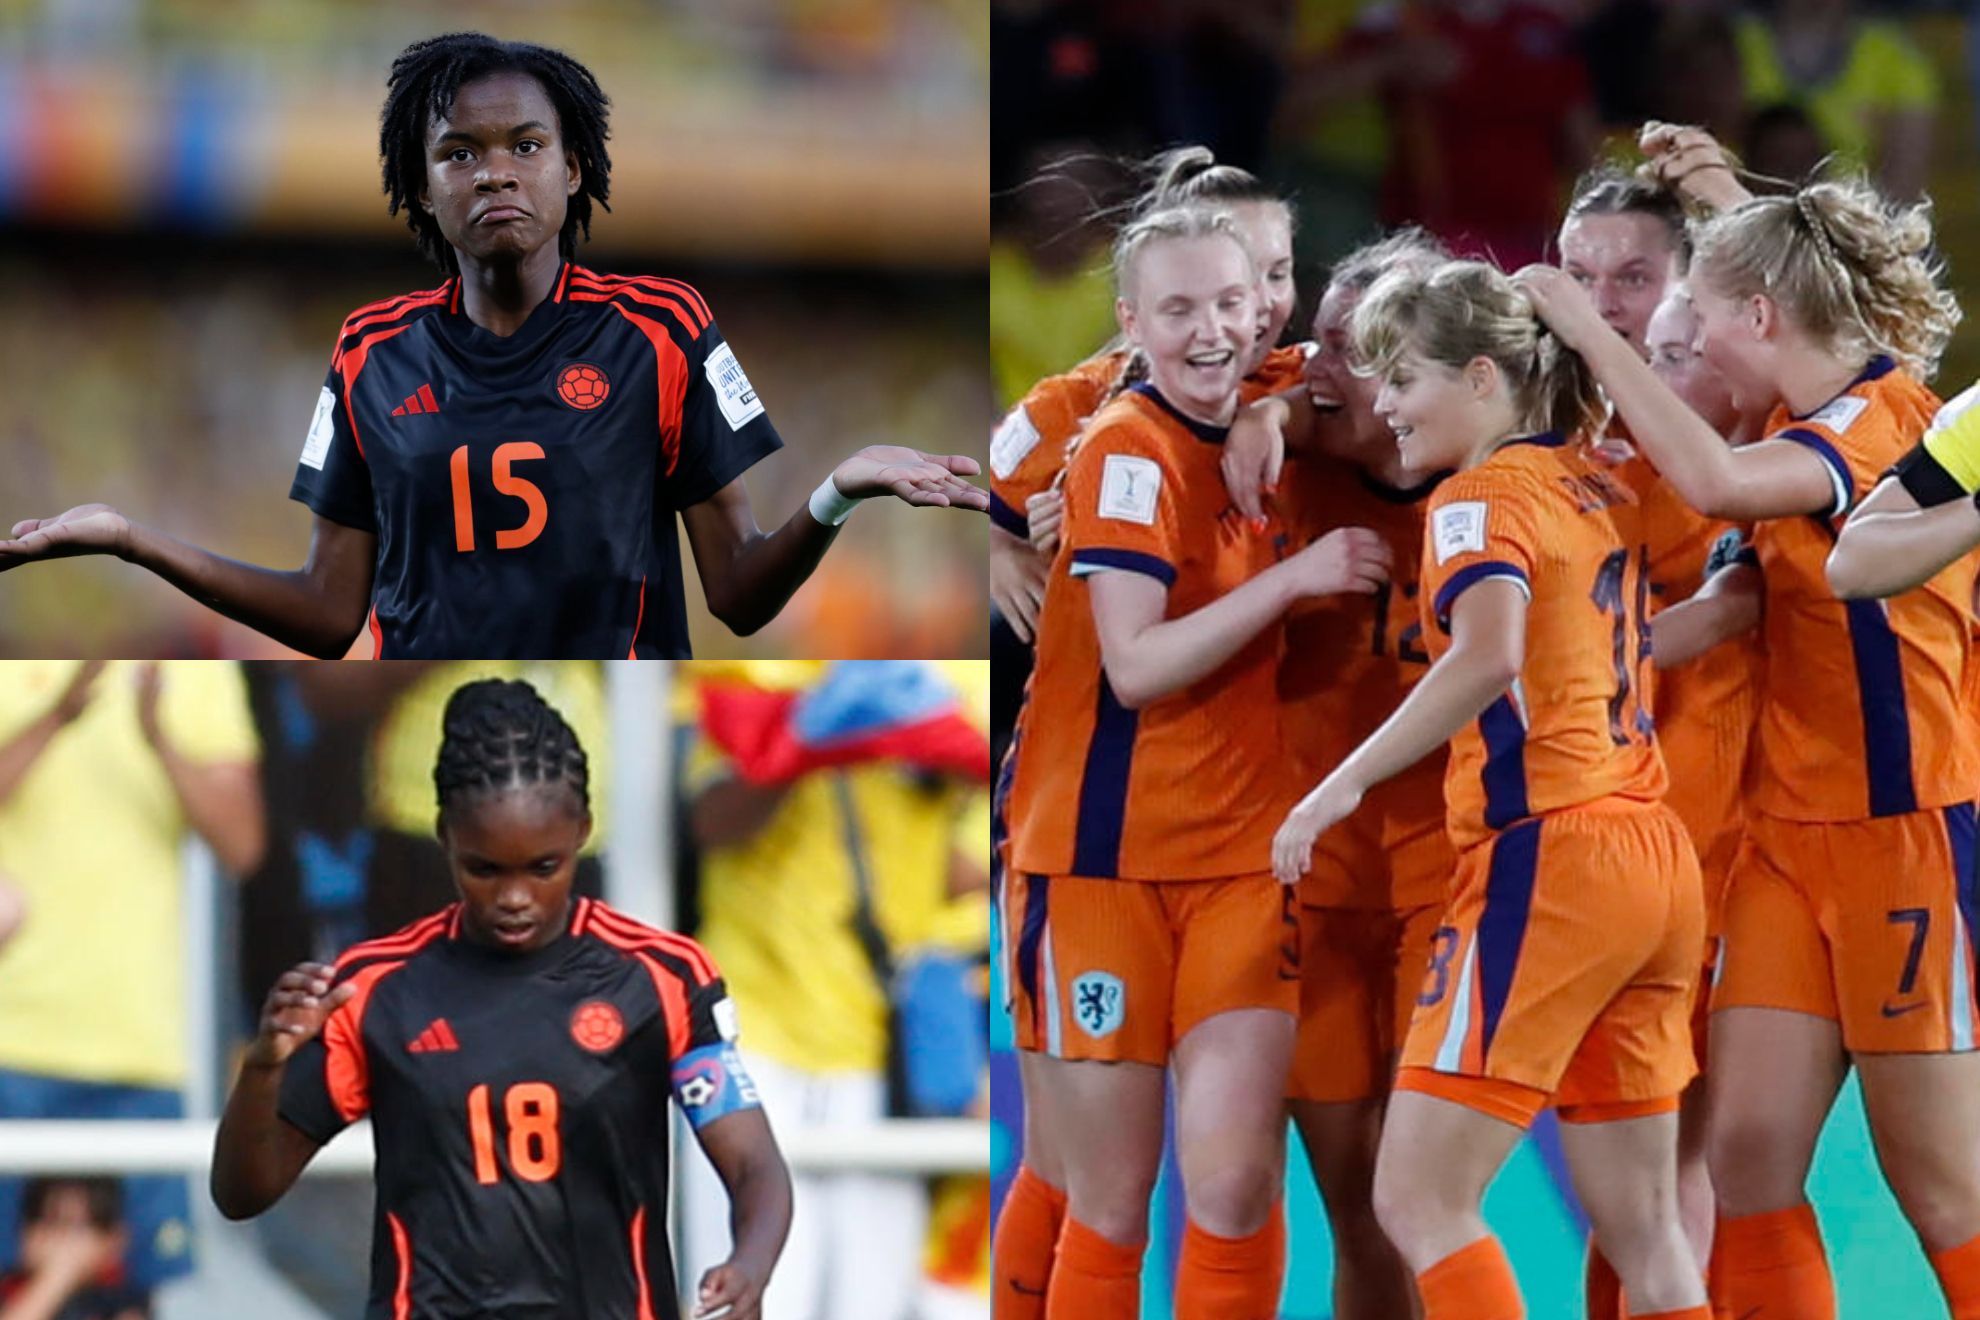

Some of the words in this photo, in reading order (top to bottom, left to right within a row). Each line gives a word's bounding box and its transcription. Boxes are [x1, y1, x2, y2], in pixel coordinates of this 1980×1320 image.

[724, 388, 738, 400] the
[450, 441, 548, 552] 15
[1887, 908, 1930, 994] 7
[467, 1082, 558, 1184] 18
